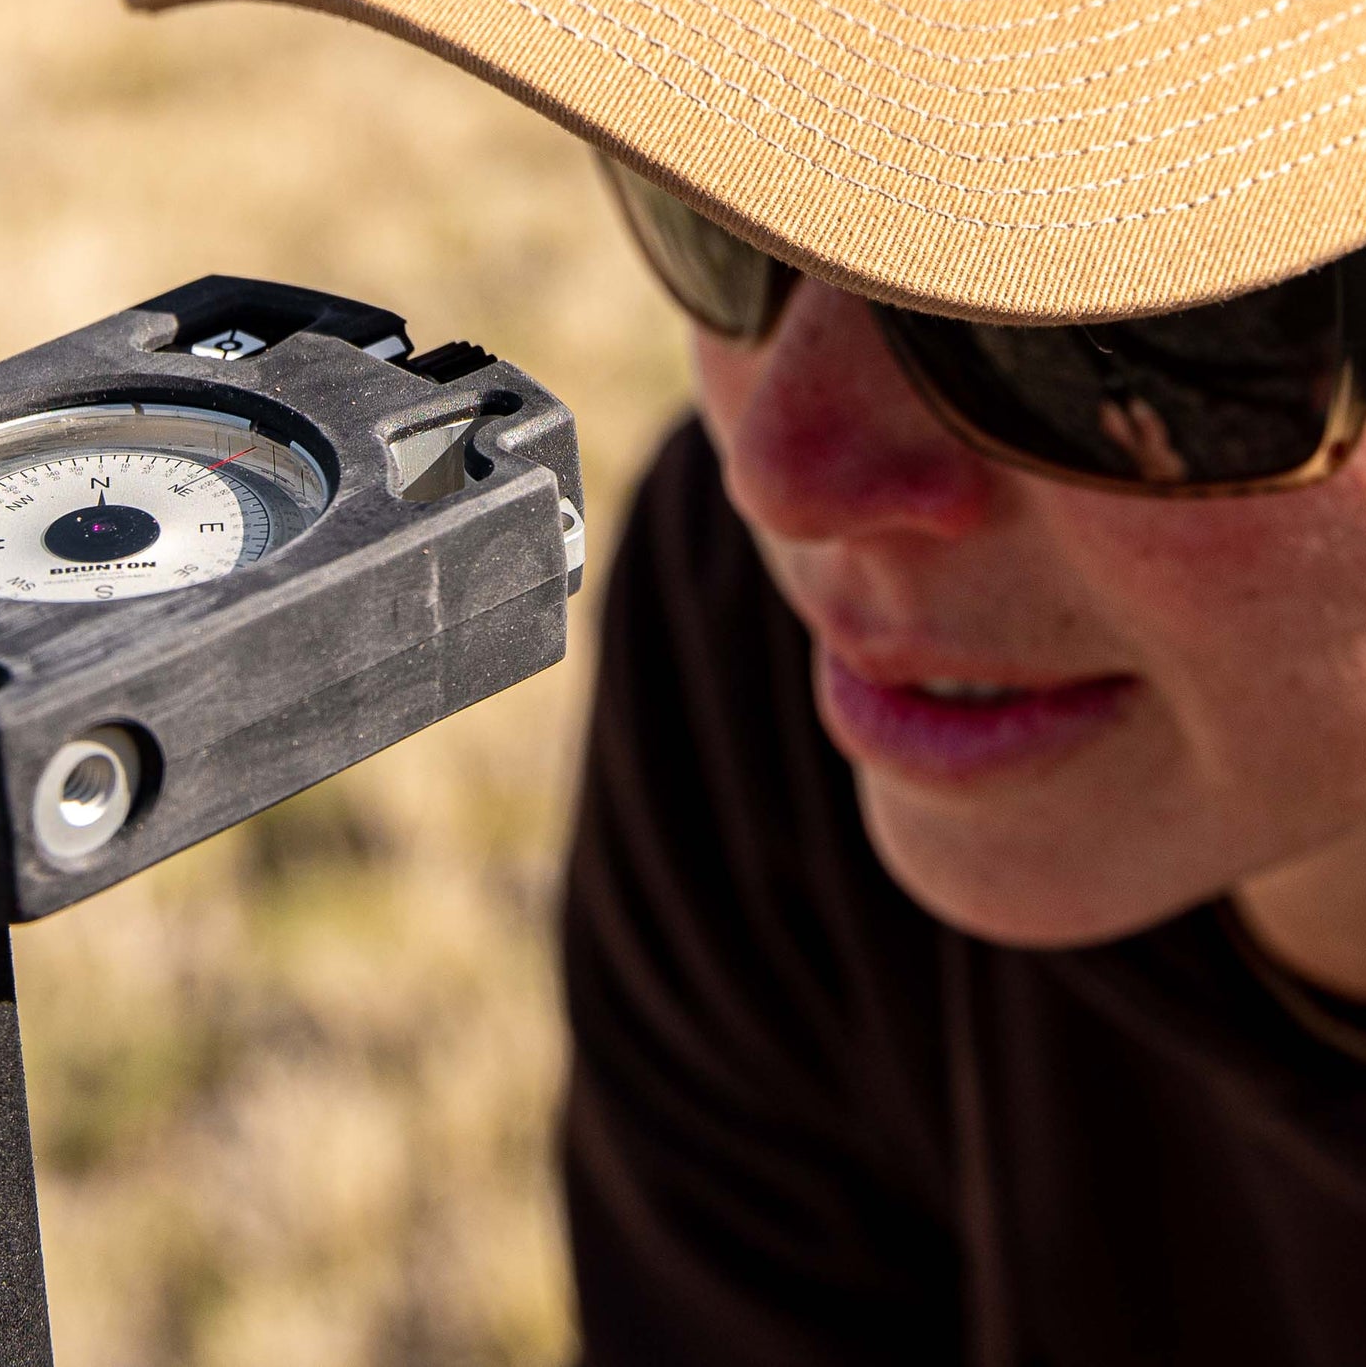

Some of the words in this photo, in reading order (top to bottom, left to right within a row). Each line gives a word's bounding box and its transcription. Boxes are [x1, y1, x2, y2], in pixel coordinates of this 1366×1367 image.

[91, 476, 110, 489] N
[167, 483, 194, 498] NE
[5, 494, 34, 512] NW
[199, 522, 224, 534] E
[50, 561, 157, 576] BRUNTON
[174, 563, 199, 579] SE
[6, 576, 37, 592] SW
[95, 584, 115, 600] S
